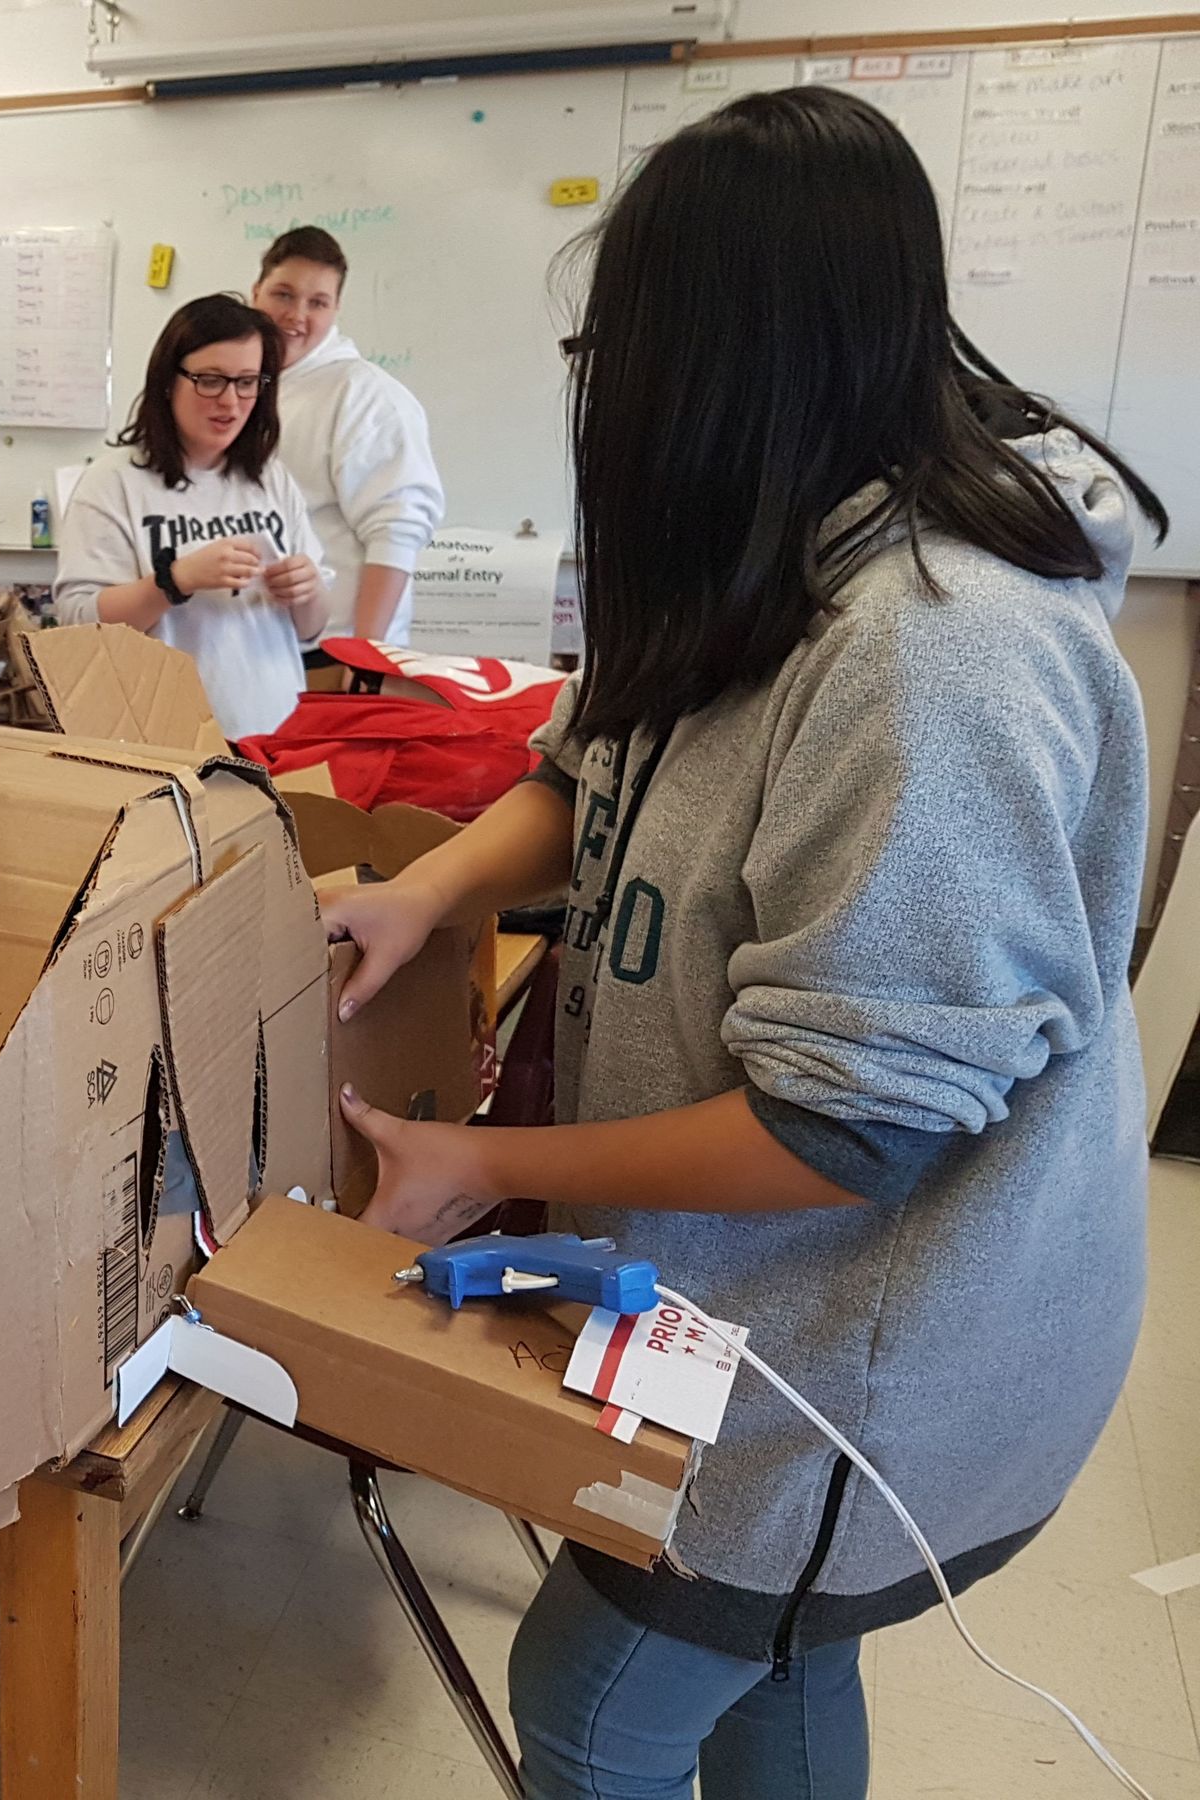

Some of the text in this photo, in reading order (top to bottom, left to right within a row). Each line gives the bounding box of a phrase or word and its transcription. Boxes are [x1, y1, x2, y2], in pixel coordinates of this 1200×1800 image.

[427, 539, 494, 554] Anatomy
[413, 568, 503, 584] ournal Entry
[86, 1069, 97, 1110] SCA
